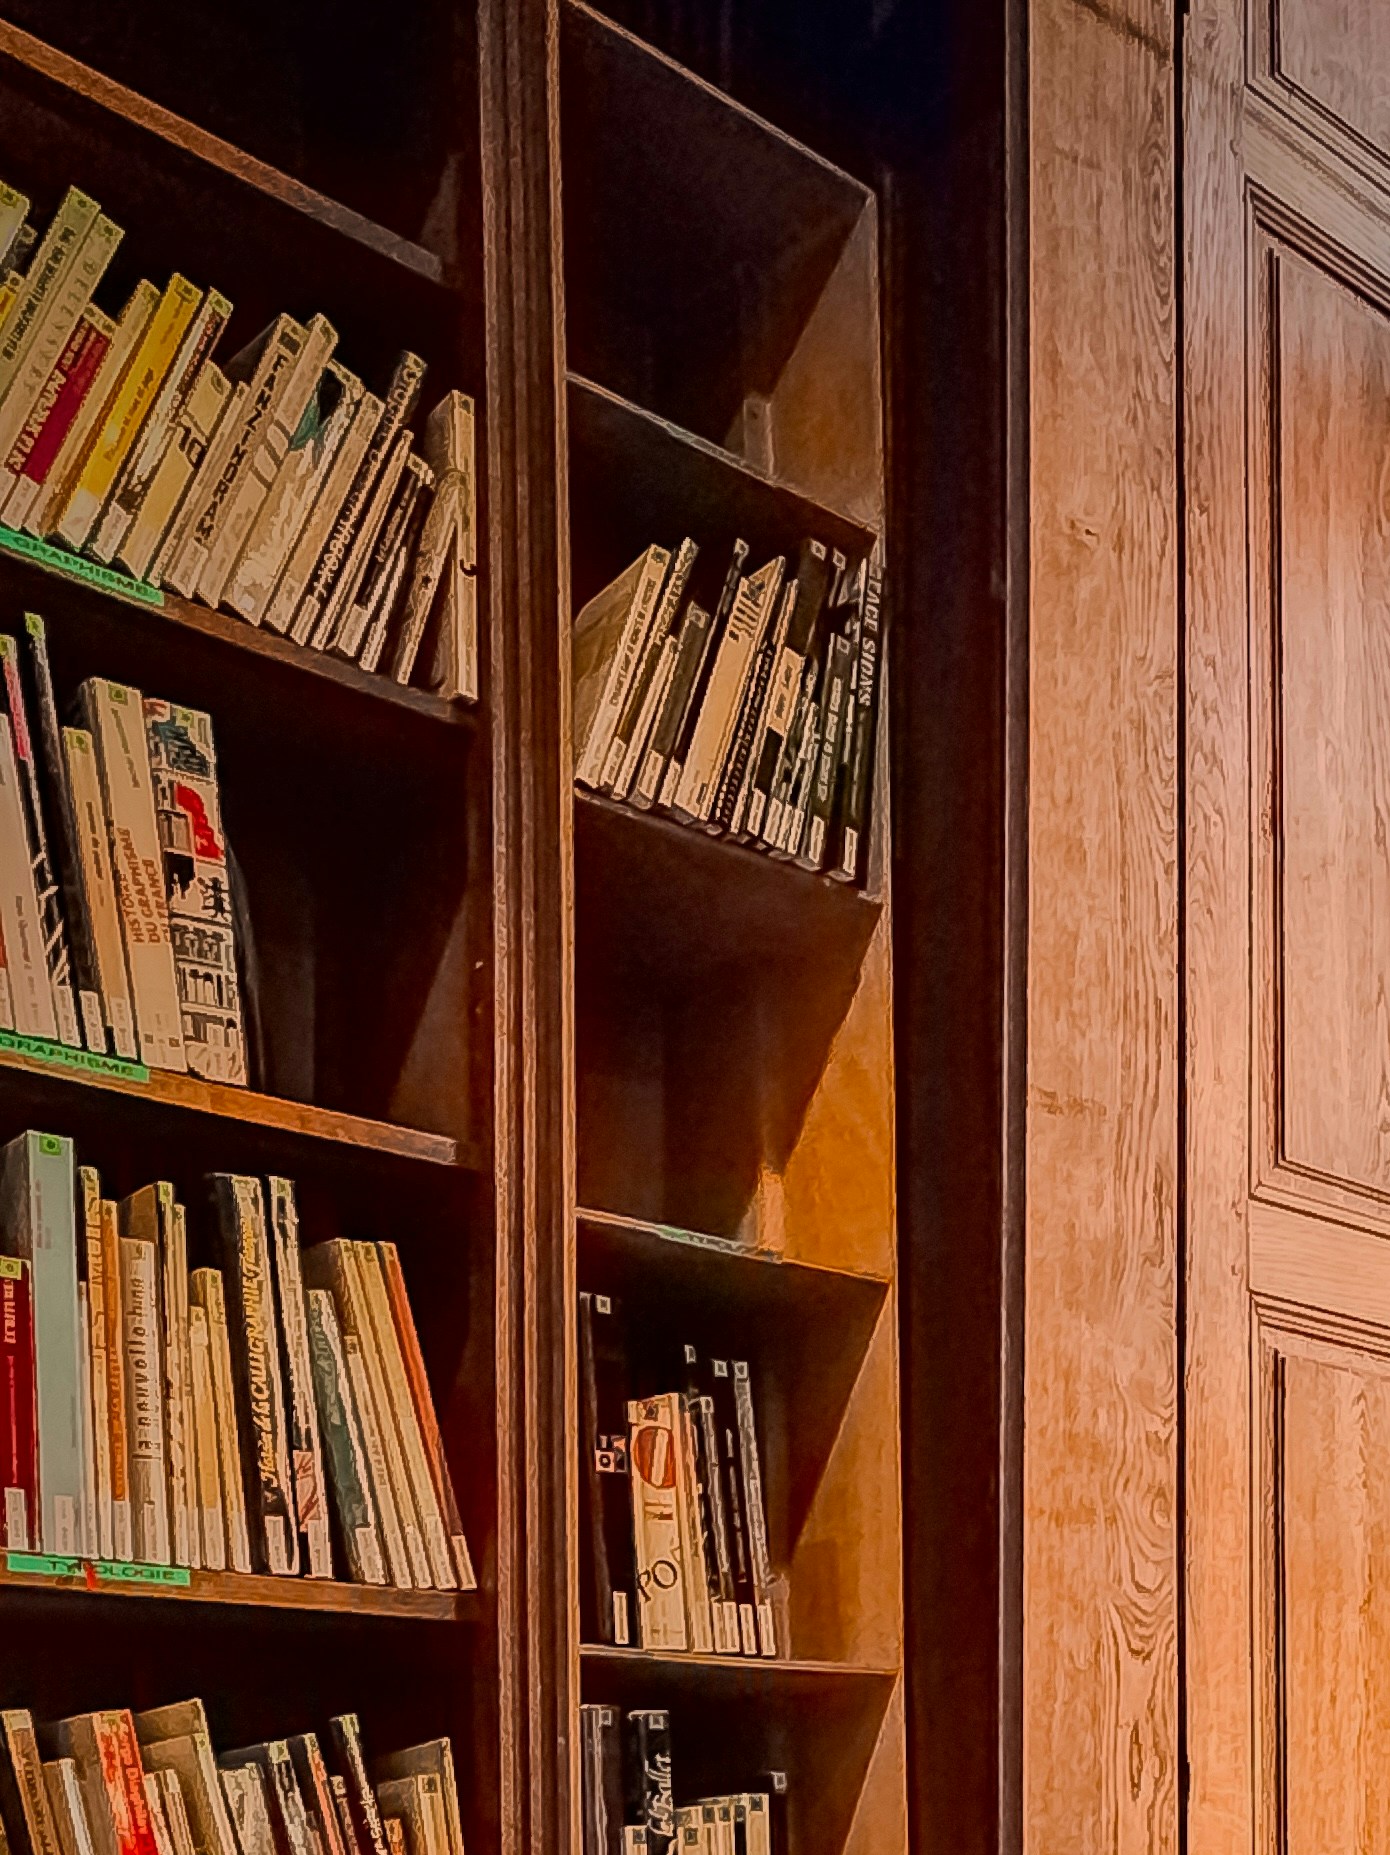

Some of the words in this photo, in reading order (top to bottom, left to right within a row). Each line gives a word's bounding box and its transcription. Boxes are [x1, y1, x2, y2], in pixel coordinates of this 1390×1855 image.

[193, 353, 288, 544] FANZINORAM
[115, 825, 154, 919] GRAPHISME
[143, 919, 161, 945] DU
